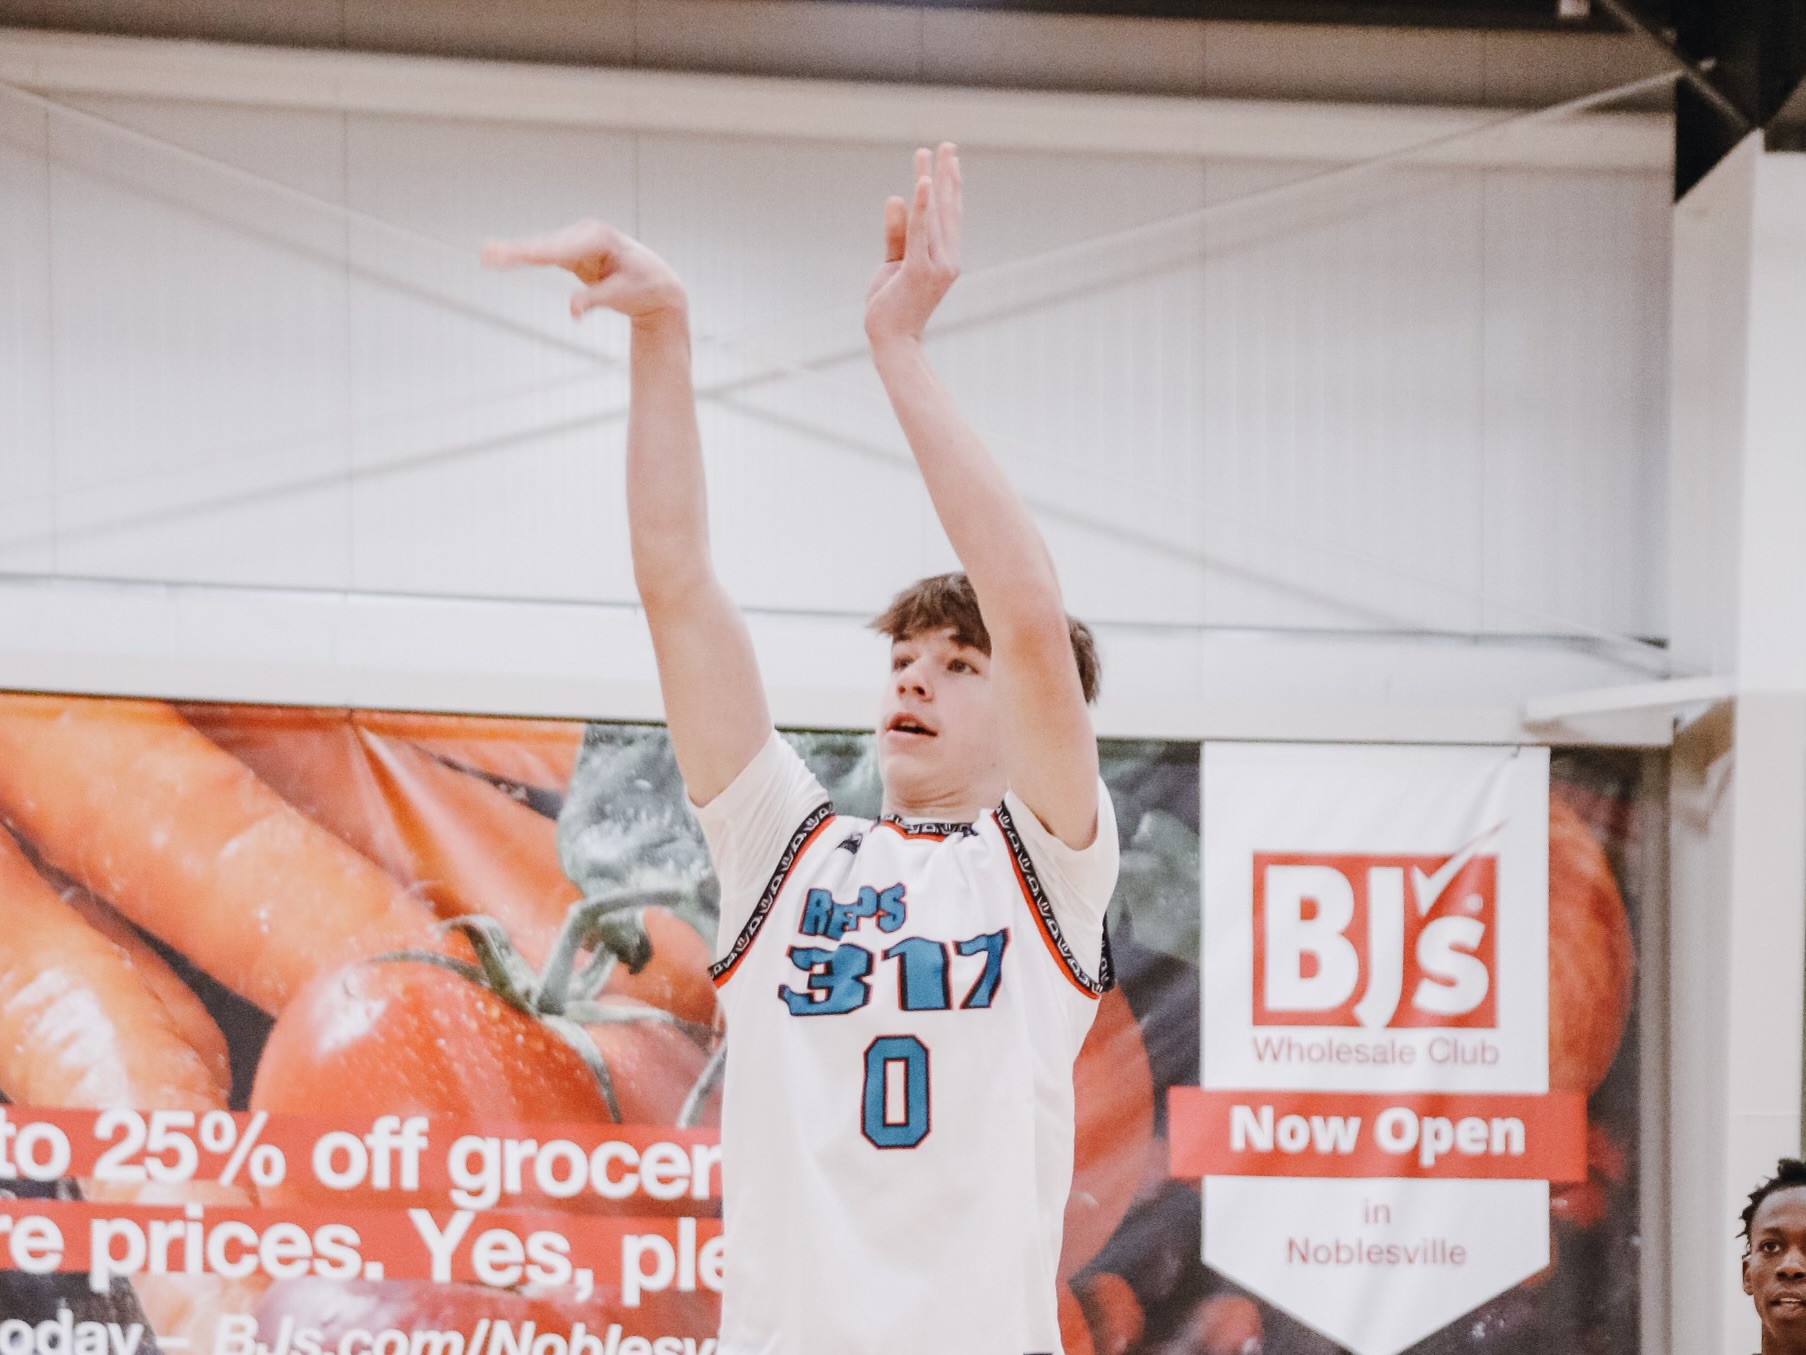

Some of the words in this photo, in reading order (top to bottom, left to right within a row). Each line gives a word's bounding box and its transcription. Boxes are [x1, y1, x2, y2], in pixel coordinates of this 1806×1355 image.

[800, 882, 908, 942] REPS
[778, 927, 1011, 1017] 317
[1252, 1035, 1418, 1065] Wholesale
[1428, 1036, 1500, 1066] Club
[860, 1034, 931, 1149] 0
[93, 1110, 287, 1188] 25%
[312, 1114, 430, 1192] off
[448, 1133, 722, 1212] grocer
[1229, 1104, 1362, 1155] Now
[1374, 1106, 1527, 1168] Open
[1363, 1198, 1392, 1225] in
[89, 1204, 385, 1294] prices.
[408, 1208, 595, 1302] Yes,
[1286, 1237, 1468, 1267] Noblesville
